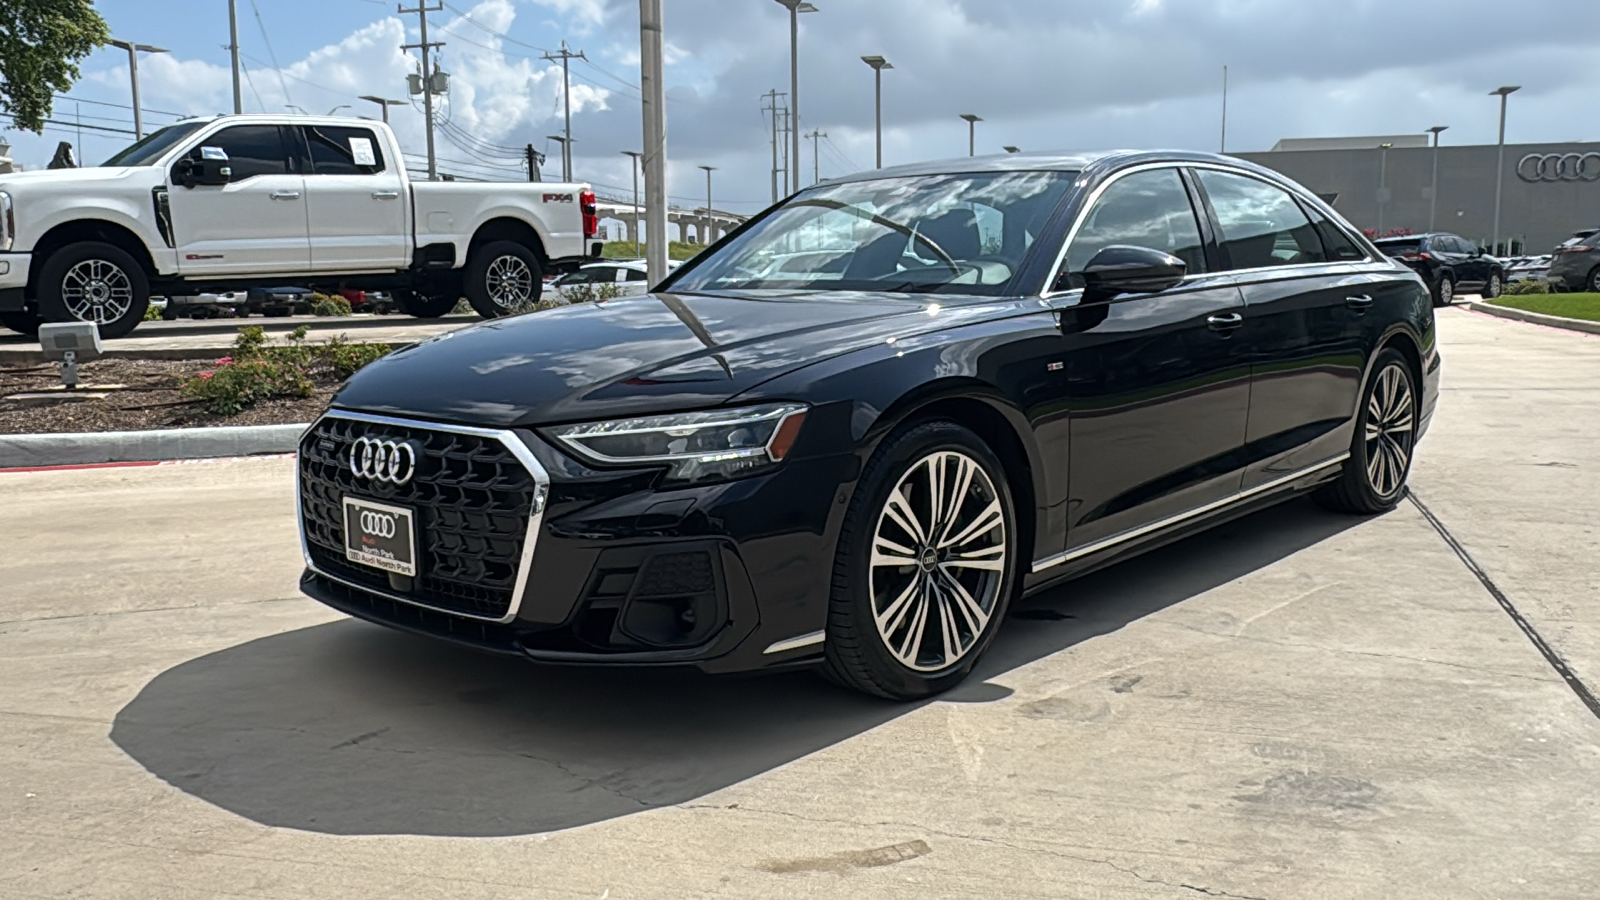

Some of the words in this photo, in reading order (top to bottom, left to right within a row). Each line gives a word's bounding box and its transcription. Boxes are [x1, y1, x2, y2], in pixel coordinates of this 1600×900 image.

[542, 193, 573, 203] FX4
[362, 545, 380, 556] North
[380, 549, 394, 560] Park
[361, 555, 376, 564] Audi
[376, 558, 396, 569] North
[396, 563, 412, 574] Park
